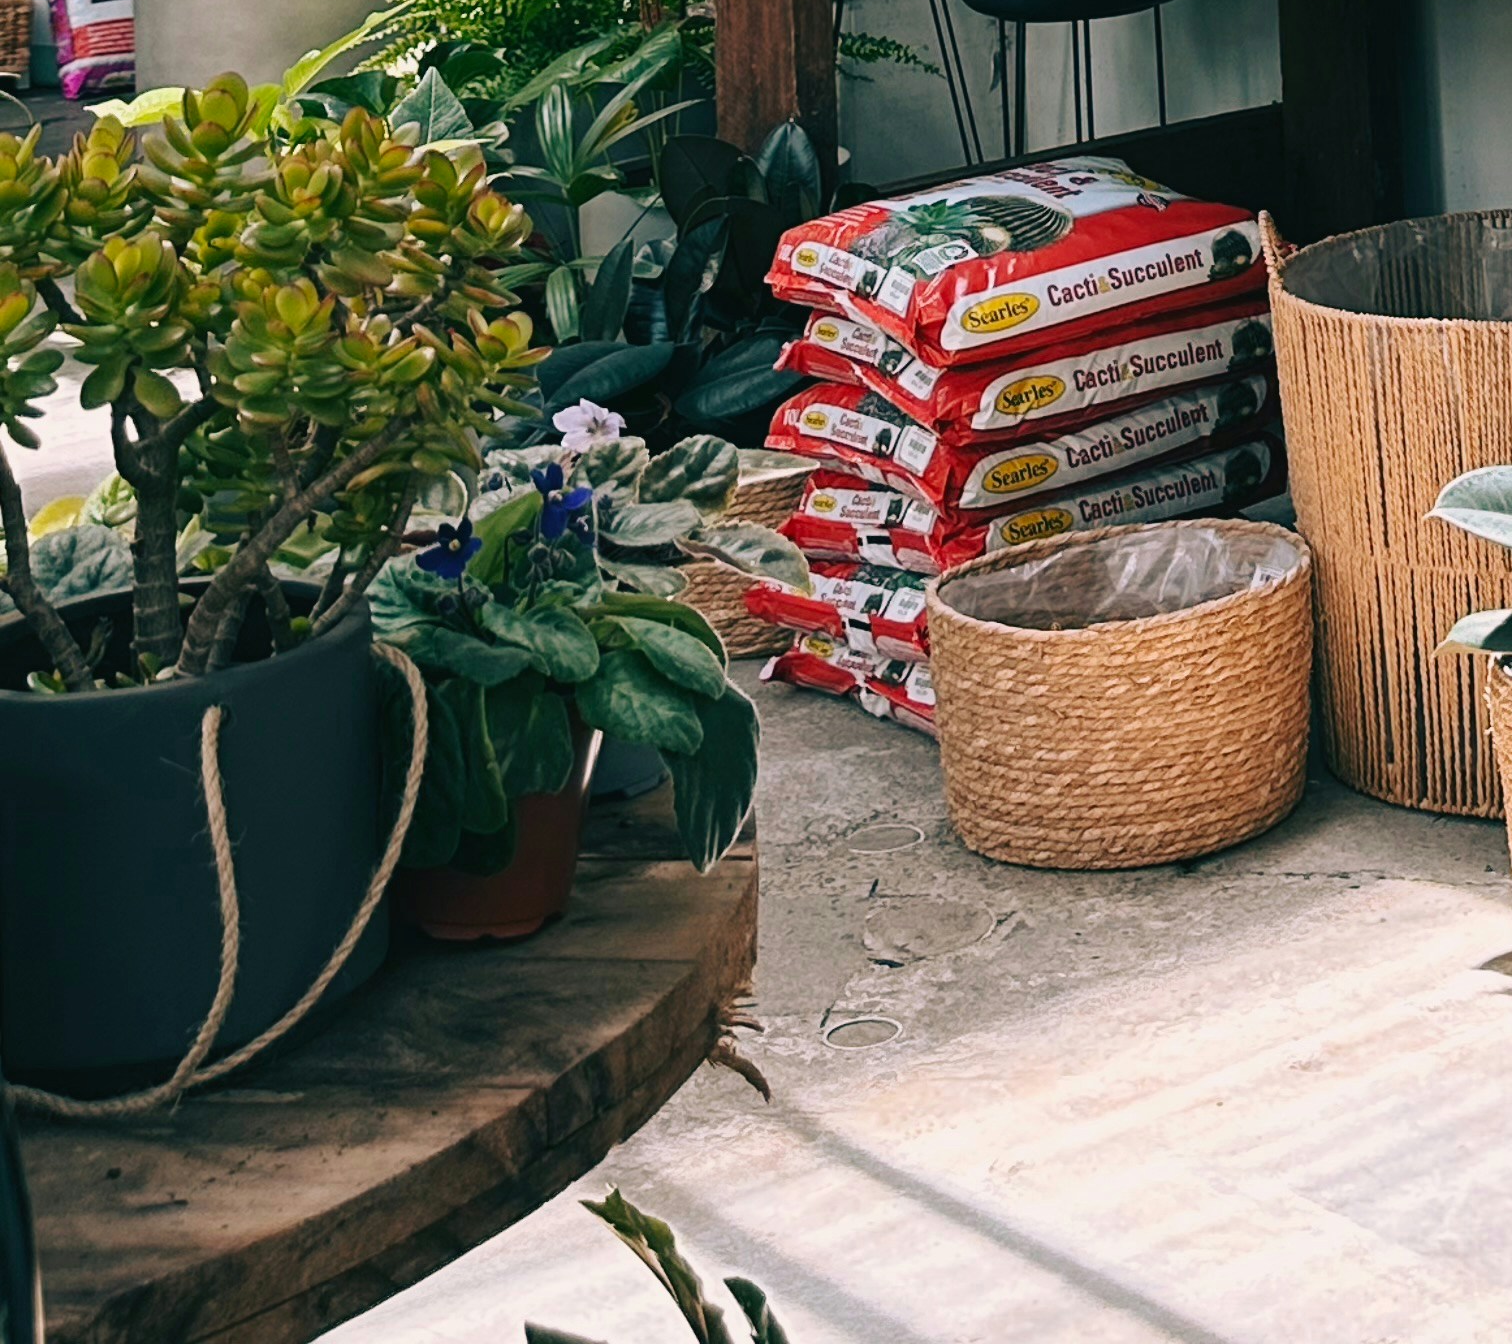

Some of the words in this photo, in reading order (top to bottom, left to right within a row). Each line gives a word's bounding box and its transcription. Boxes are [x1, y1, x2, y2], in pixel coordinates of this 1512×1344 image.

[967, 298, 1027, 328] Searles
[1046, 273, 1098, 306] Cacti
[1107, 248, 1204, 290] Succulent
[1002, 379, 1055, 409] Searles
[1072, 359, 1120, 392] Cacti
[1129, 338, 1225, 379] Succulent
[991, 457, 1049, 489] Searles
[1065, 435, 1113, 469] Cacti
[1119, 402, 1210, 450] Succulent
[1008, 511, 1064, 541] Searles
[1078, 490, 1124, 523] Cacti
[1131, 469, 1218, 508] Succulent
